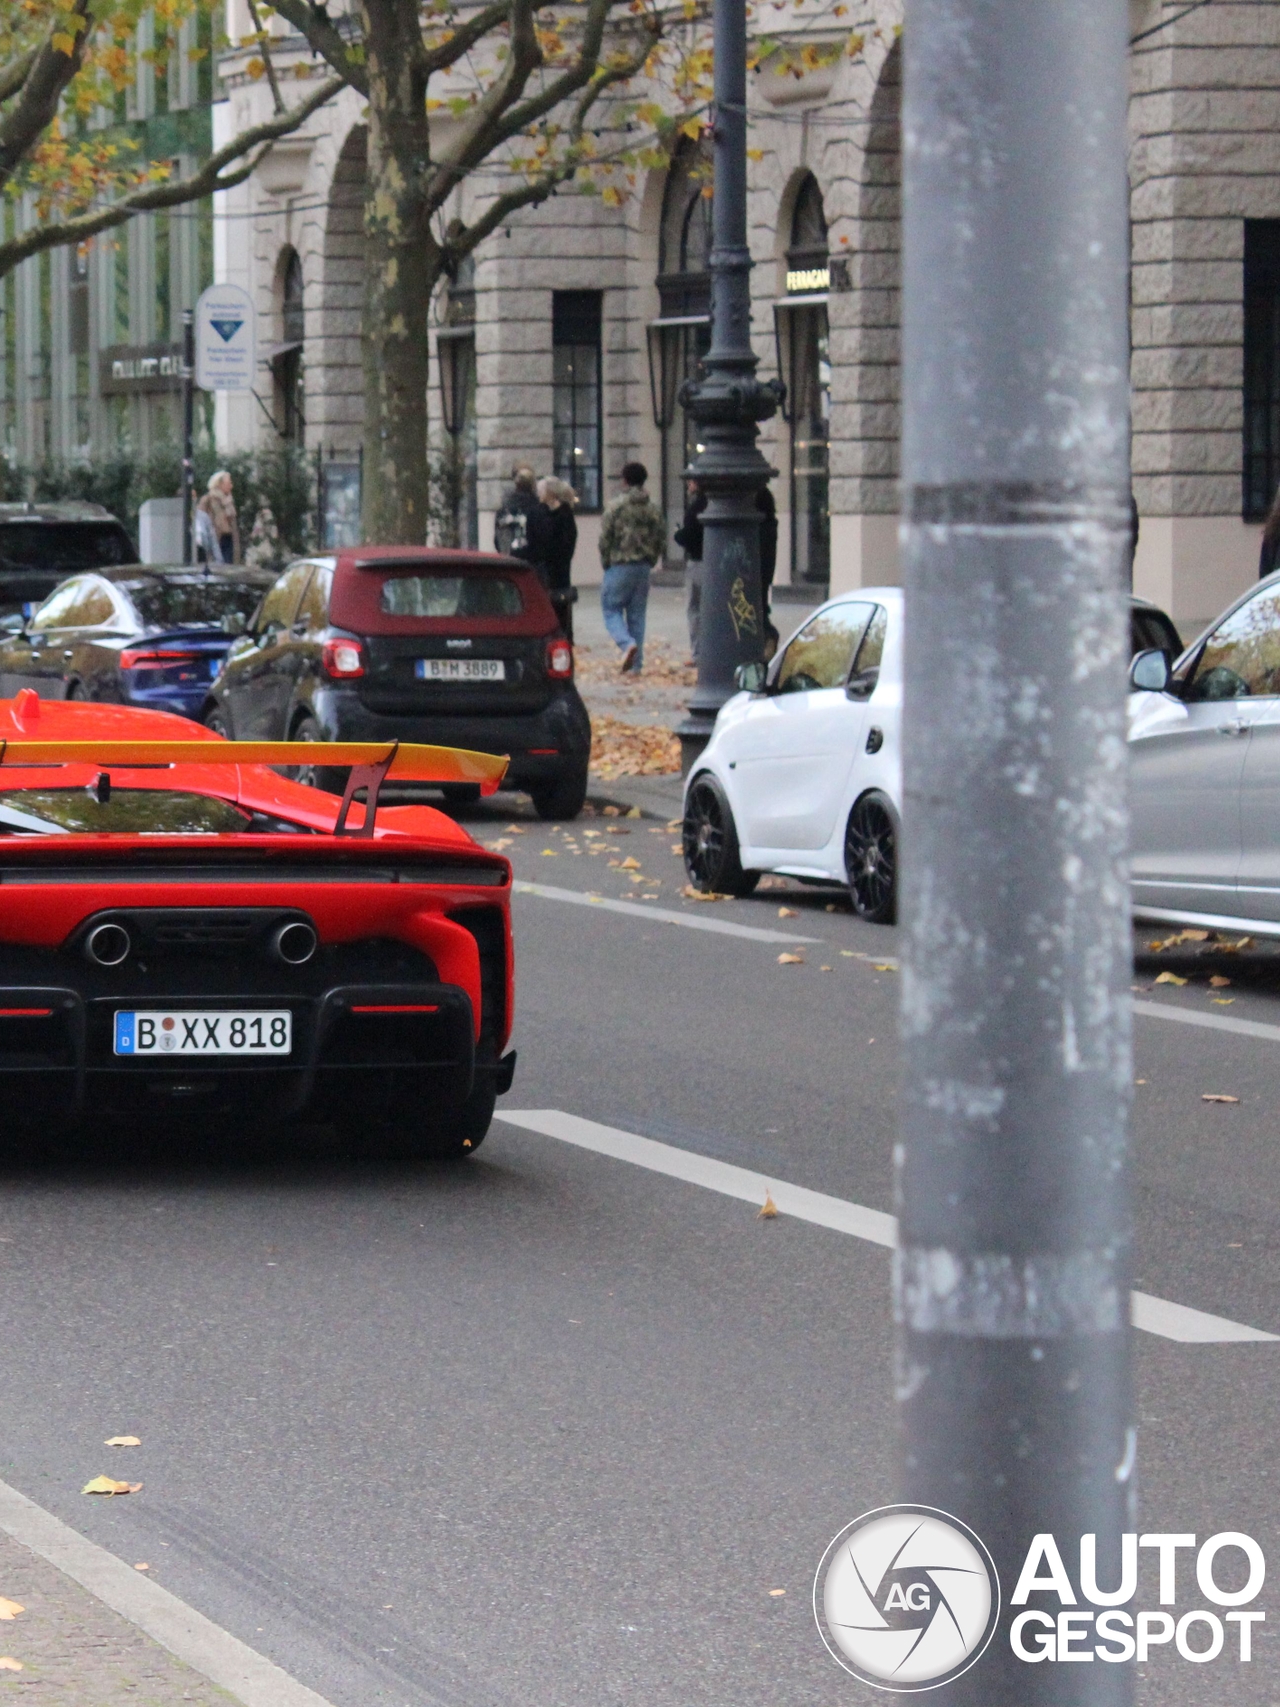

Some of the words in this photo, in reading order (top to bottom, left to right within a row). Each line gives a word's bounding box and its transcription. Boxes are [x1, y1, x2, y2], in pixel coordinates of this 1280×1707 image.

[431, 660, 439, 676] B
[464, 660, 498, 676] 3889
[122, 1037, 130, 1046] D
[138, 1018, 157, 1049] B
[181, 1018, 221, 1049] XX
[229, 1017, 287, 1049] 818
